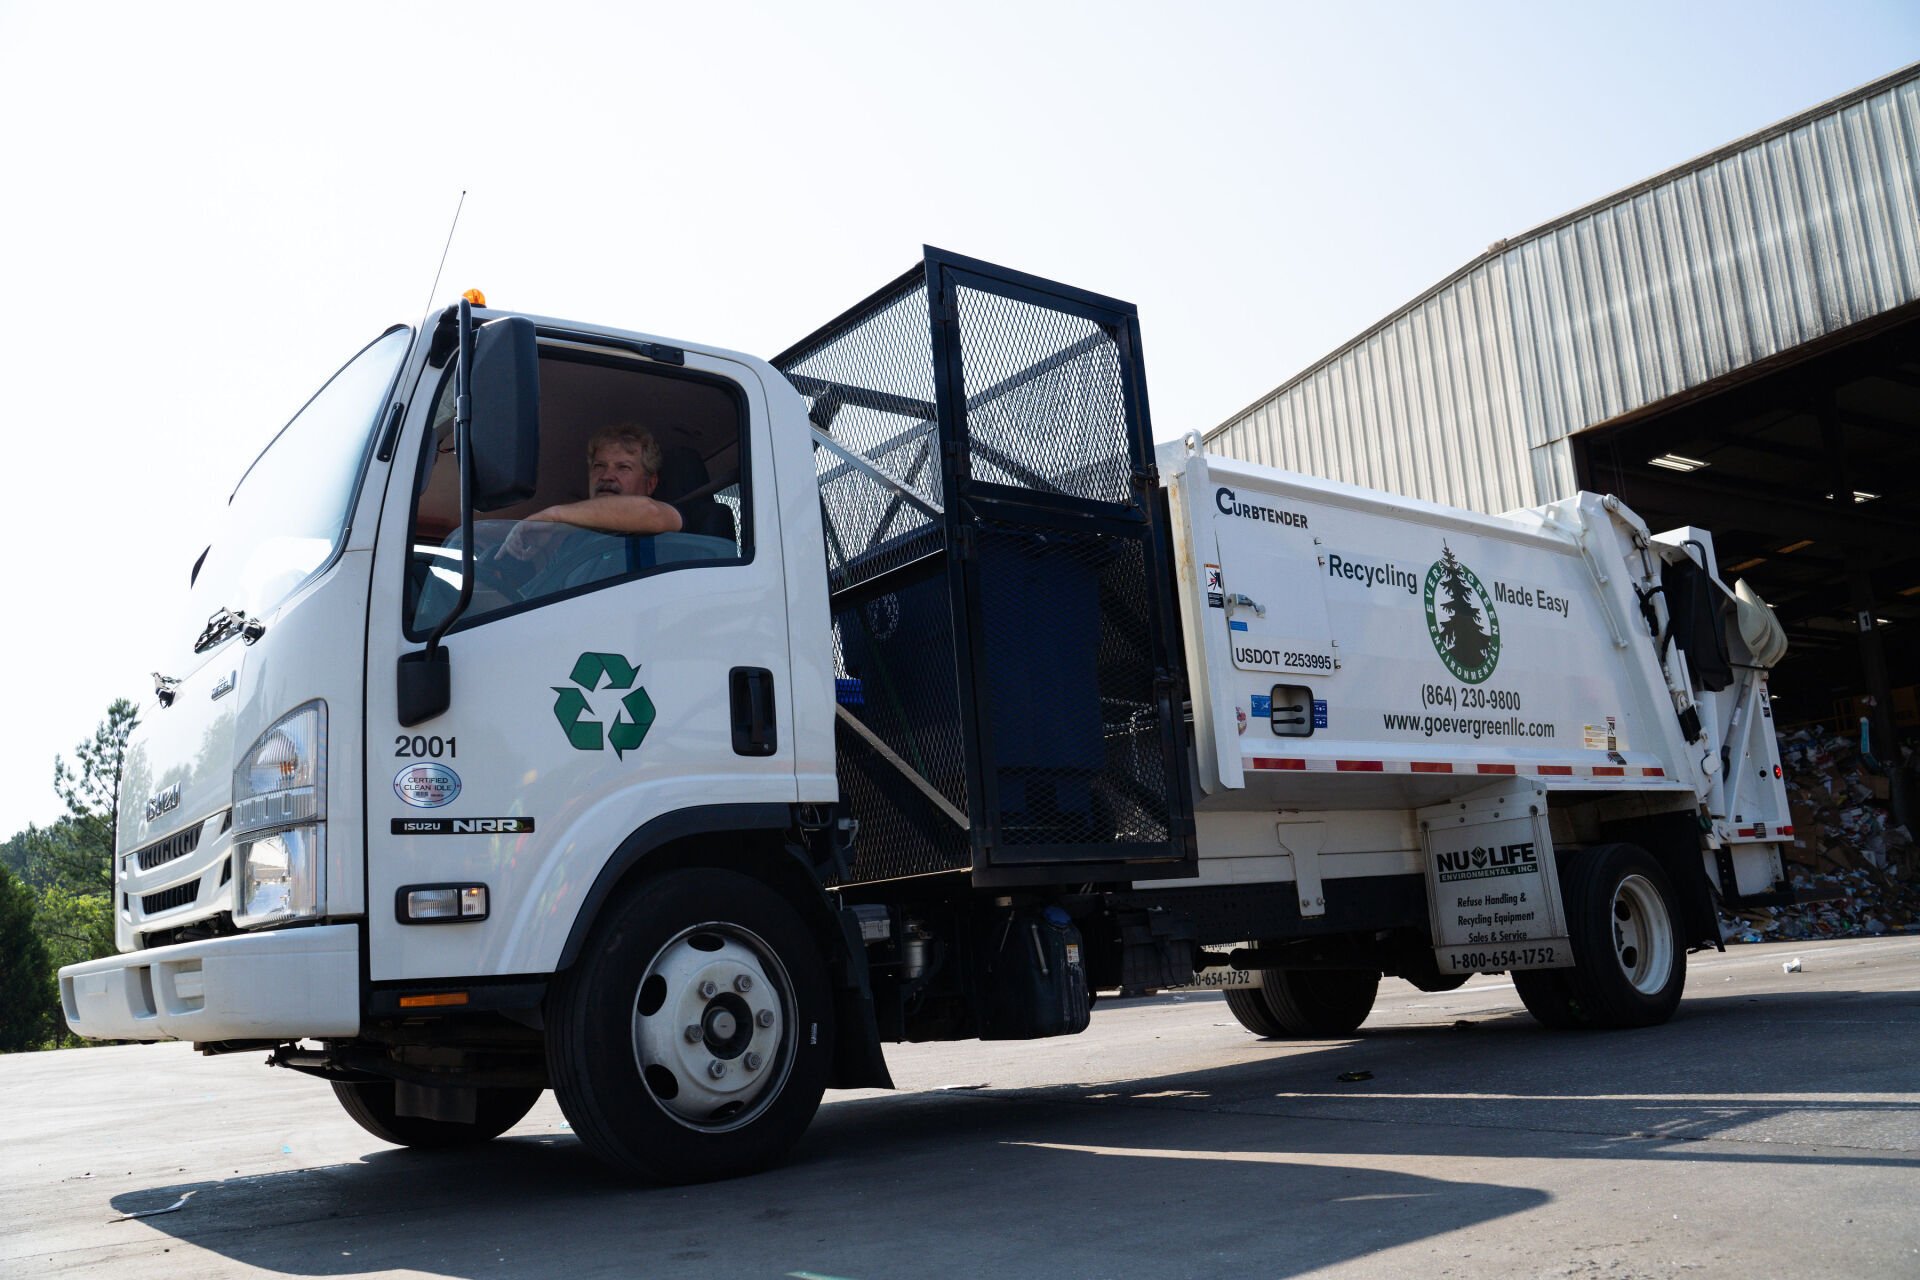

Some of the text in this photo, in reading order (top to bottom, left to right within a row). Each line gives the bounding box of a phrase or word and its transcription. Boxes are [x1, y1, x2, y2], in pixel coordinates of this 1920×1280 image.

[1215, 487, 1308, 529] CURBTENDER
[1329, 554, 1417, 595] Recycling
[1494, 581, 1569, 618] Made Easy
[1235, 647, 1331, 670] USDOT 2253995
[1430, 625, 1498, 680] ENVIRONMENTAL
[1421, 683, 1521, 711] (864) 230-9800
[1383, 713, 1555, 739] www.goevergreenllc.com
[394, 735, 456, 758] 2001
[404, 819, 518, 833] ISUZU NRR
[1436, 842, 1537, 872] NU LIFE
[1518, 864, 1536, 873] INC.
[1457, 892, 1526, 907] Refuse Handling &
[1458, 911, 1534, 927] Recycling Equipment
[1469, 929, 1527, 943] Sales & Service
[1450, 947, 1555, 970] 1-800-654-1752
